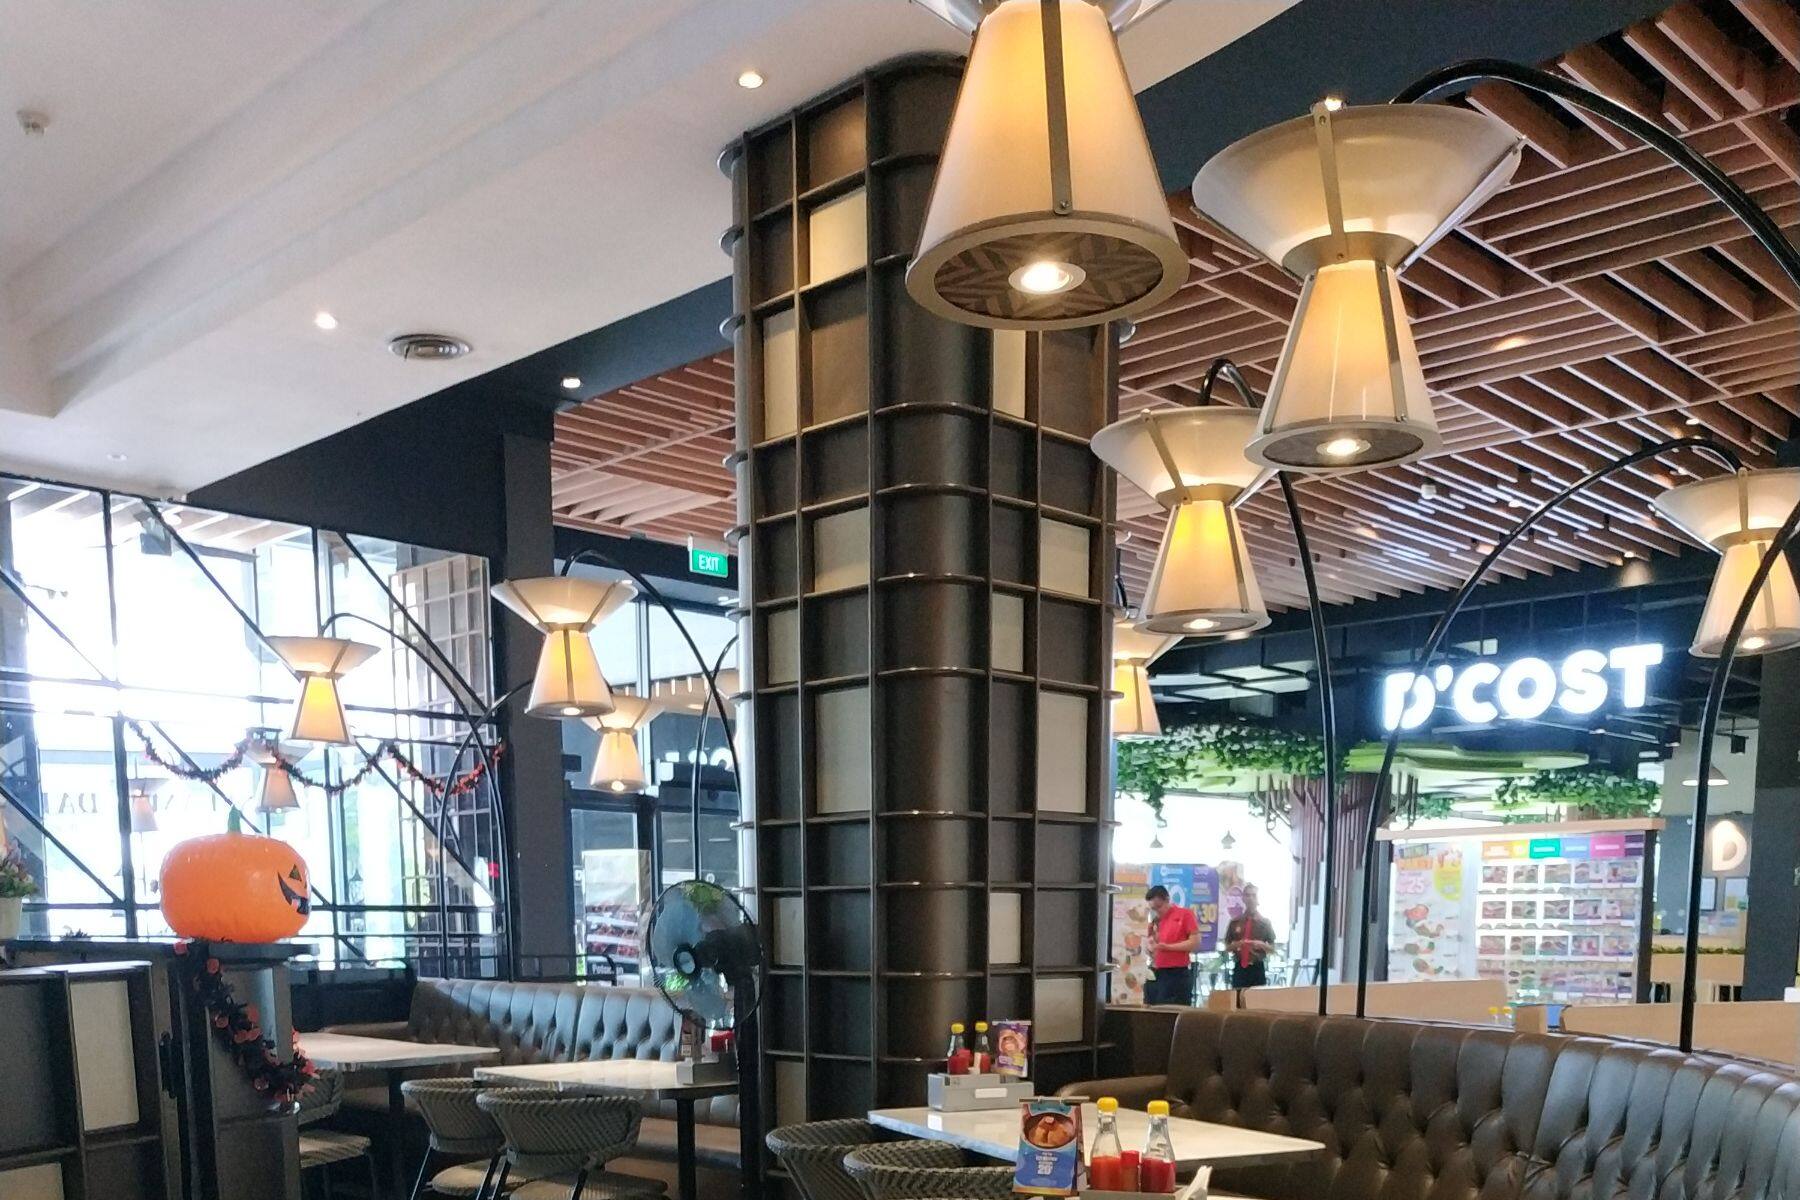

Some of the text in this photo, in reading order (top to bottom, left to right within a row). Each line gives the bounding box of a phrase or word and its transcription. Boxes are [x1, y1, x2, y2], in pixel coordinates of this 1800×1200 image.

[698, 554, 720, 572] EXIT
[1383, 643, 1664, 732] D'COST
[1711, 820, 1747, 872] D
